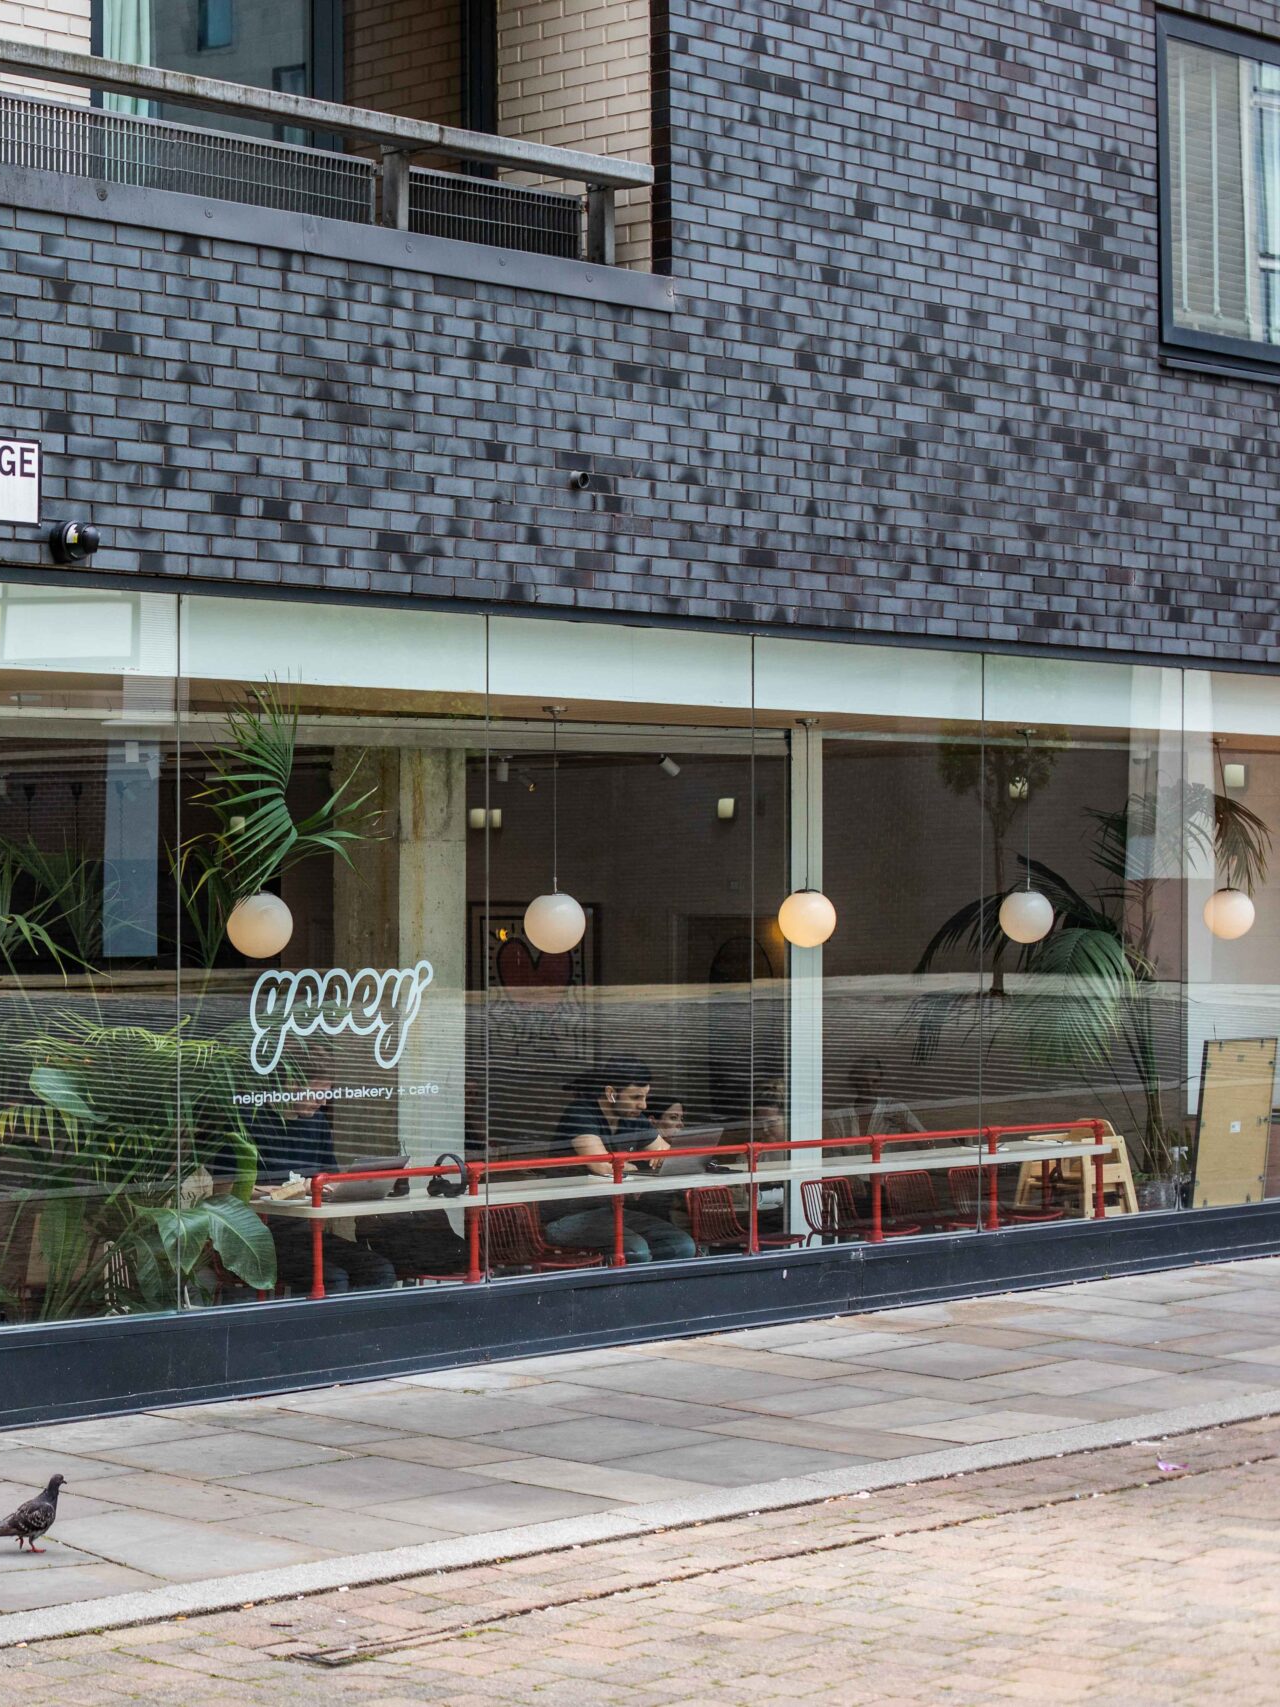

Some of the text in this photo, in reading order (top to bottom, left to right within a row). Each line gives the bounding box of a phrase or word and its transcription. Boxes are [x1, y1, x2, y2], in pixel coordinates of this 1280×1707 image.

[250, 960, 434, 1075] gooey
[232, 1087, 342, 1107] neighbourhood
[345, 1085, 393, 1100] bakery
[409, 1082, 439, 1096] cafe
